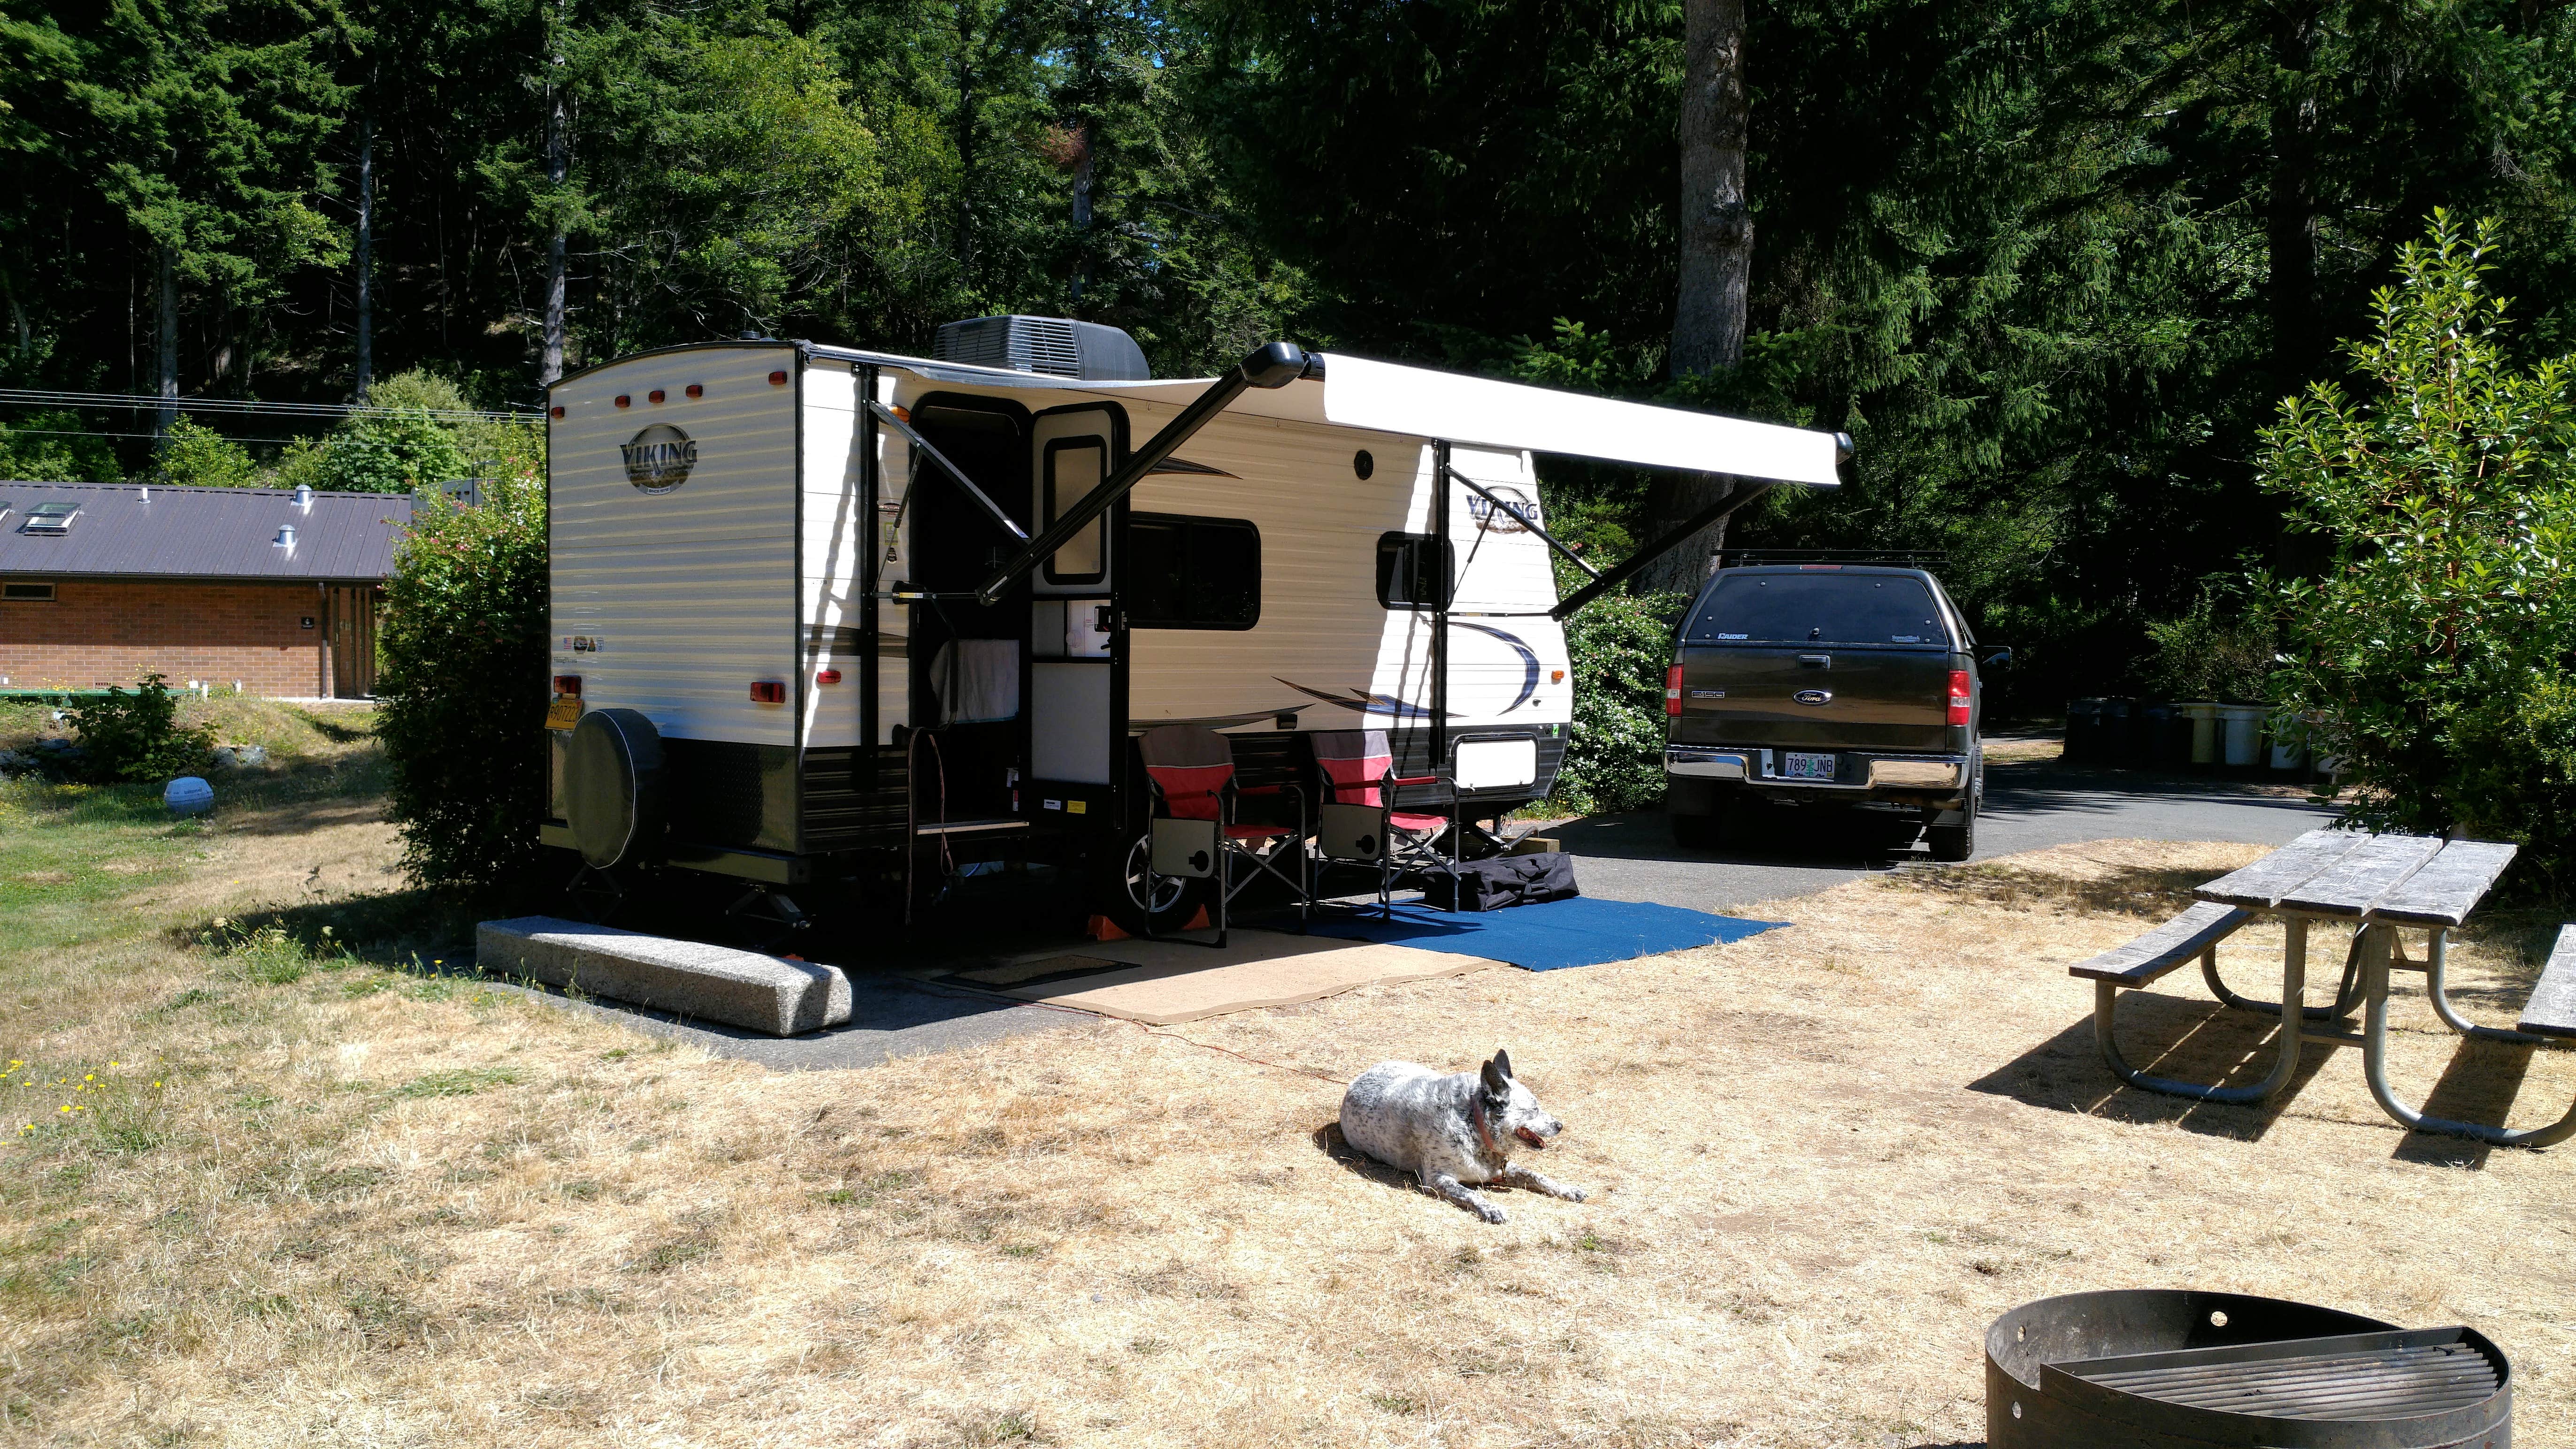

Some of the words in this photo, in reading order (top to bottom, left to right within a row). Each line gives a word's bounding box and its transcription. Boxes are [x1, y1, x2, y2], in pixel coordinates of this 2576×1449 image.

[620, 440, 698, 476] VIKING
[1802, 693, 1822, 702] Ford
[1787, 758, 1807, 771] 789
[1814, 759, 1833, 772] JNB
